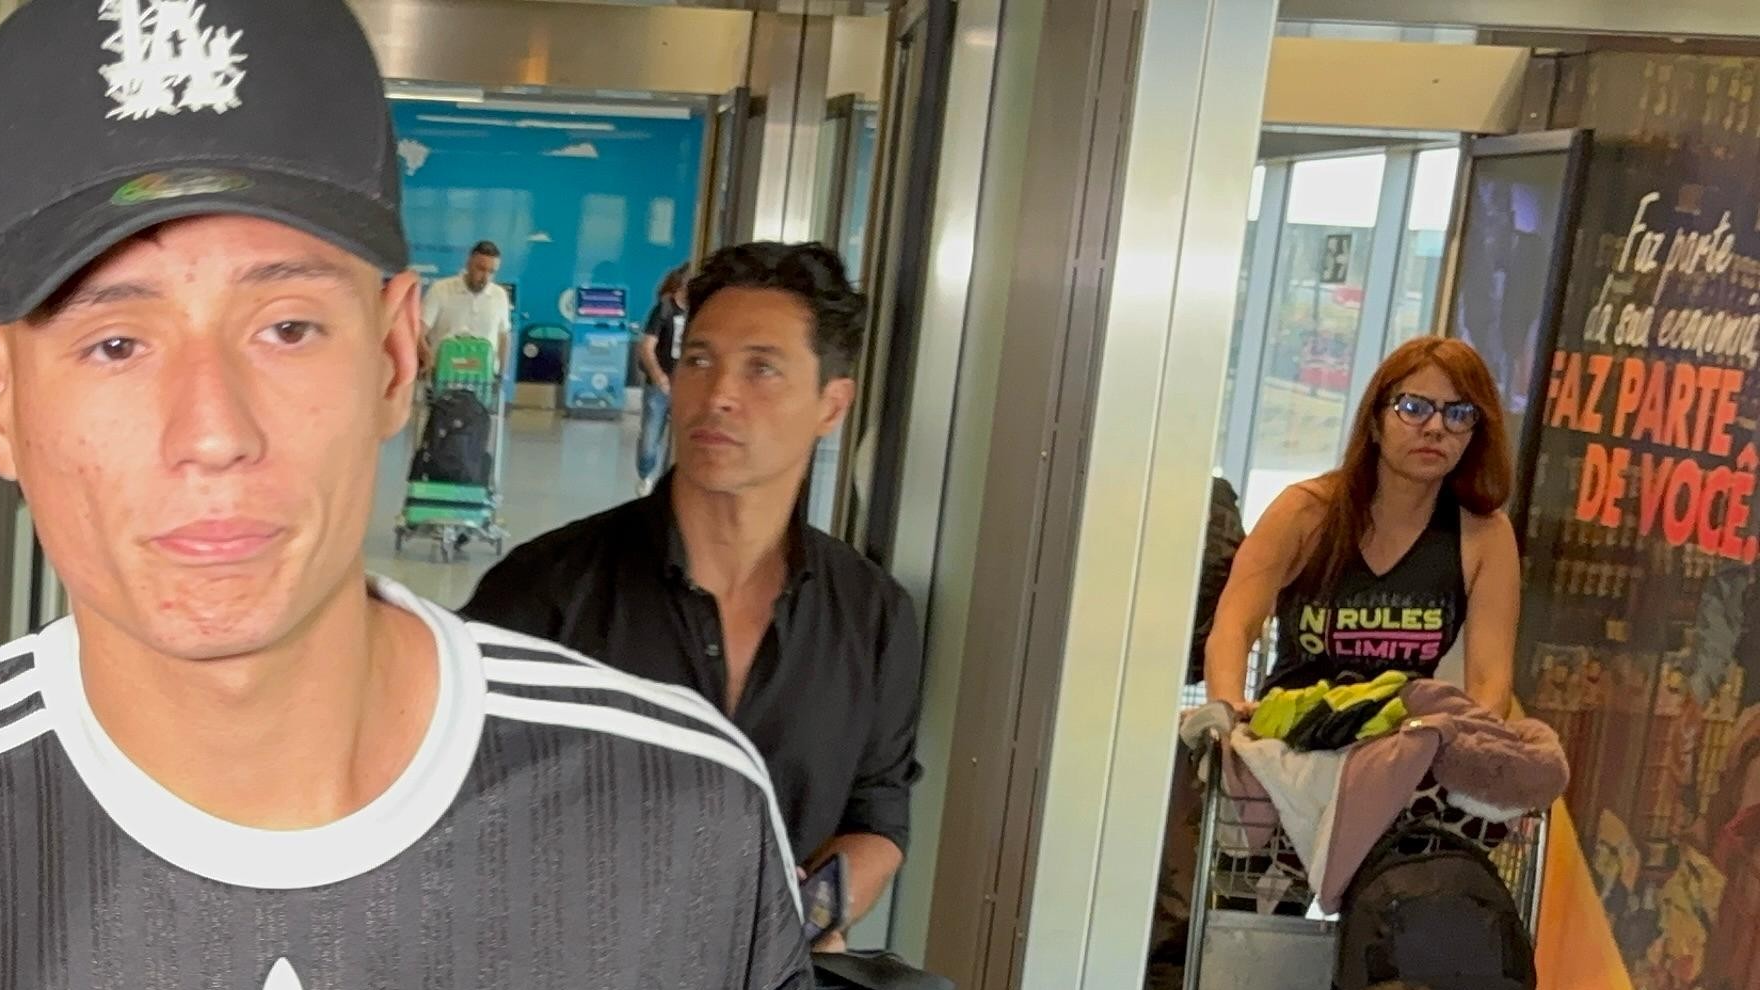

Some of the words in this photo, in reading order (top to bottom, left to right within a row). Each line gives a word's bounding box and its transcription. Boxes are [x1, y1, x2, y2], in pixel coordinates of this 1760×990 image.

[1617, 191, 1666, 274] Faz
[1651, 210, 1736, 305] parte
[1612, 357, 1745, 457] PARTE
[1575, 442, 1632, 529] DE
[1335, 639, 1440, 661] LIMITS
[1336, 606, 1443, 631] RULES
